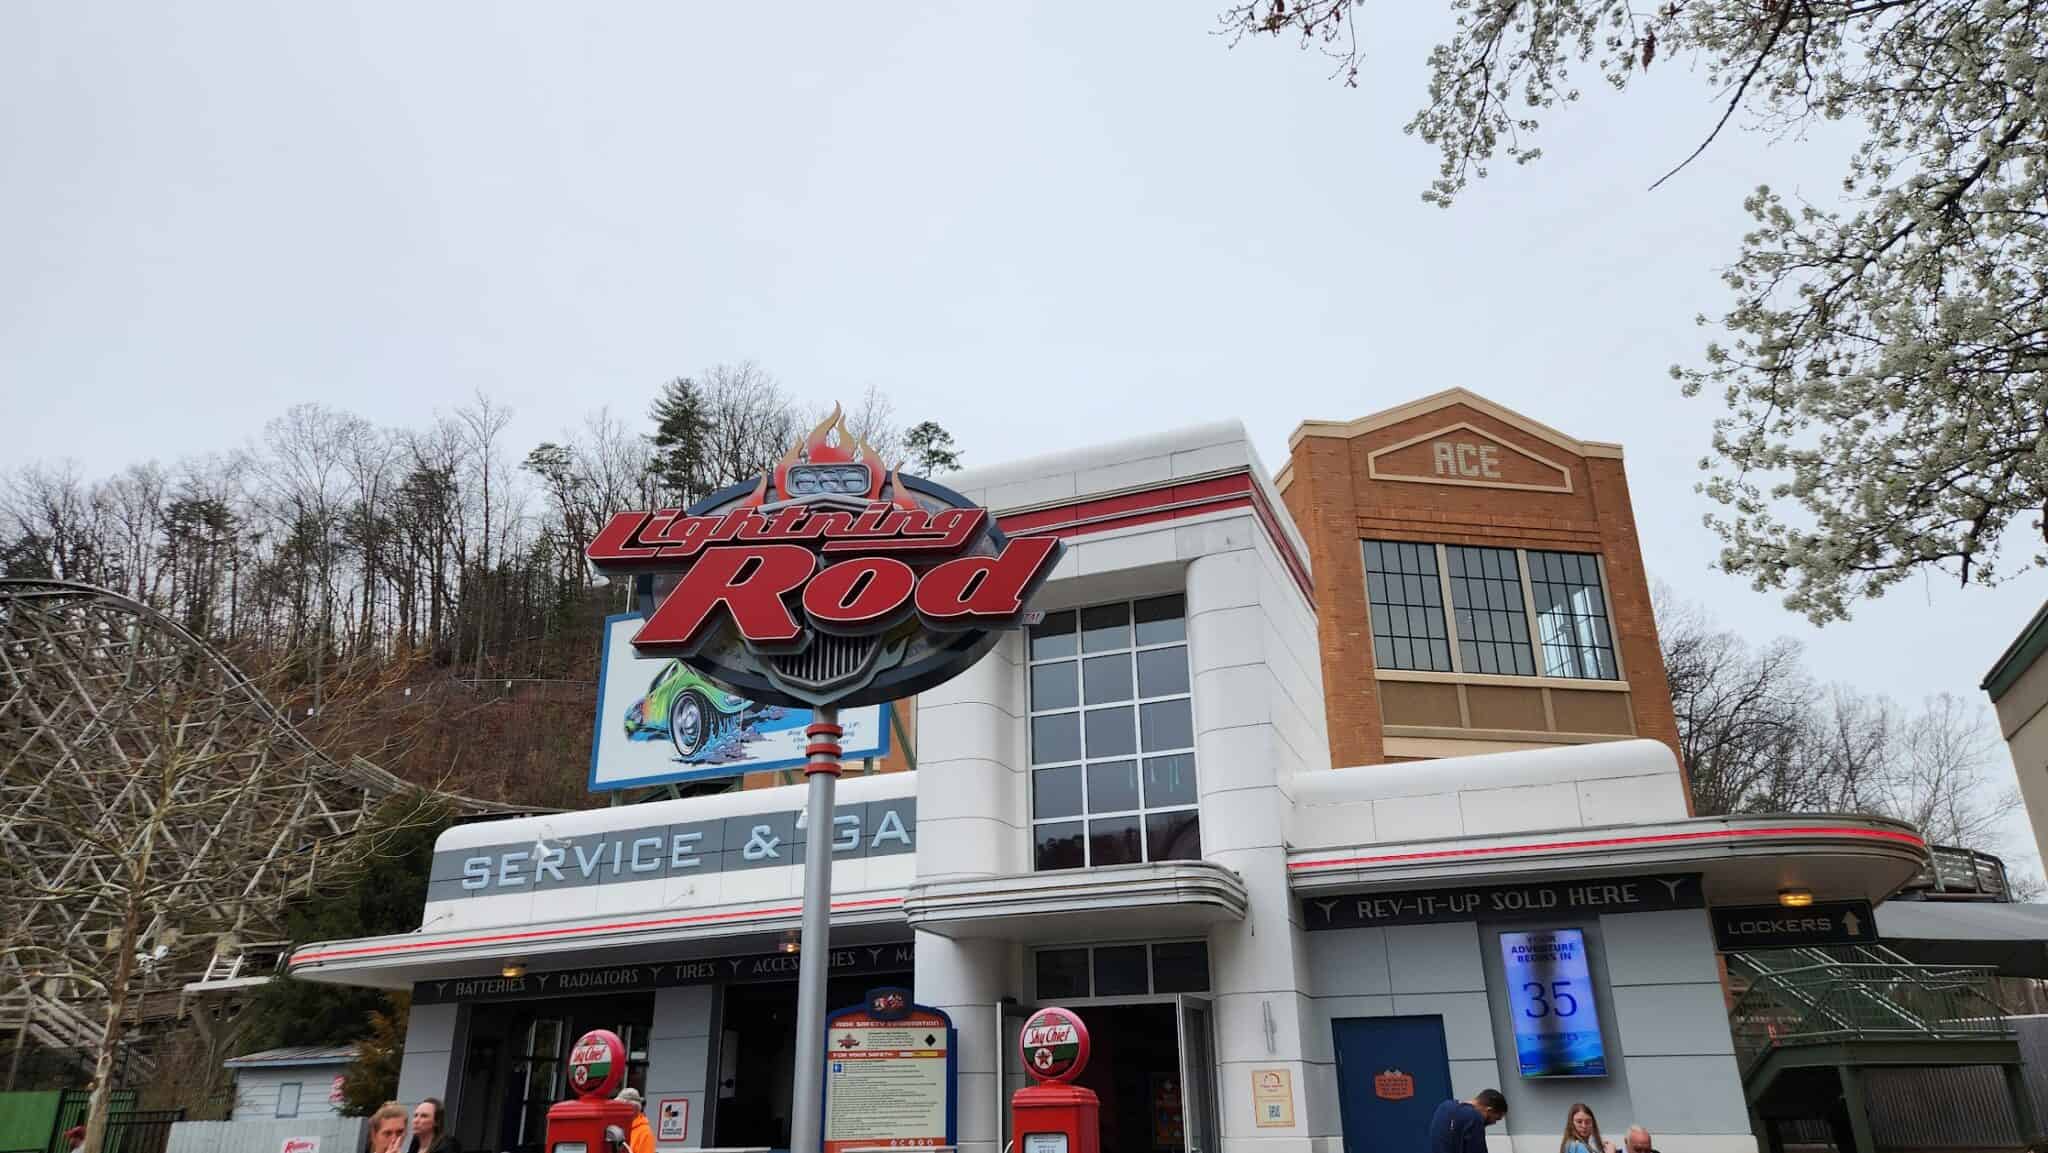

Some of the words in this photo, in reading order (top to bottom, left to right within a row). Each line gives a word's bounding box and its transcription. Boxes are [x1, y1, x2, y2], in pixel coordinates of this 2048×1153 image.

[1432, 441, 1503, 478] ACE
[586, 503, 985, 559] Lightning
[632, 536, 1061, 644] Rod
[462, 832, 702, 891] SERVICE
[743, 825, 781, 861] &
[1358, 893, 1480, 919] REV-IT-UP
[1491, 889, 1557, 911] SOLD
[1568, 884, 1640, 906] HERE
[1727, 918, 1833, 935] LOCKERS
[675, 963, 715, 980] TIRES
[752, 951, 856, 974] ACCESIES
[456, 978, 527, 996] BATTERIES
[559, 969, 639, 988] RADIATORS
[1522, 981, 1578, 1018] 35
[1046, 1026, 1071, 1042] Chief
